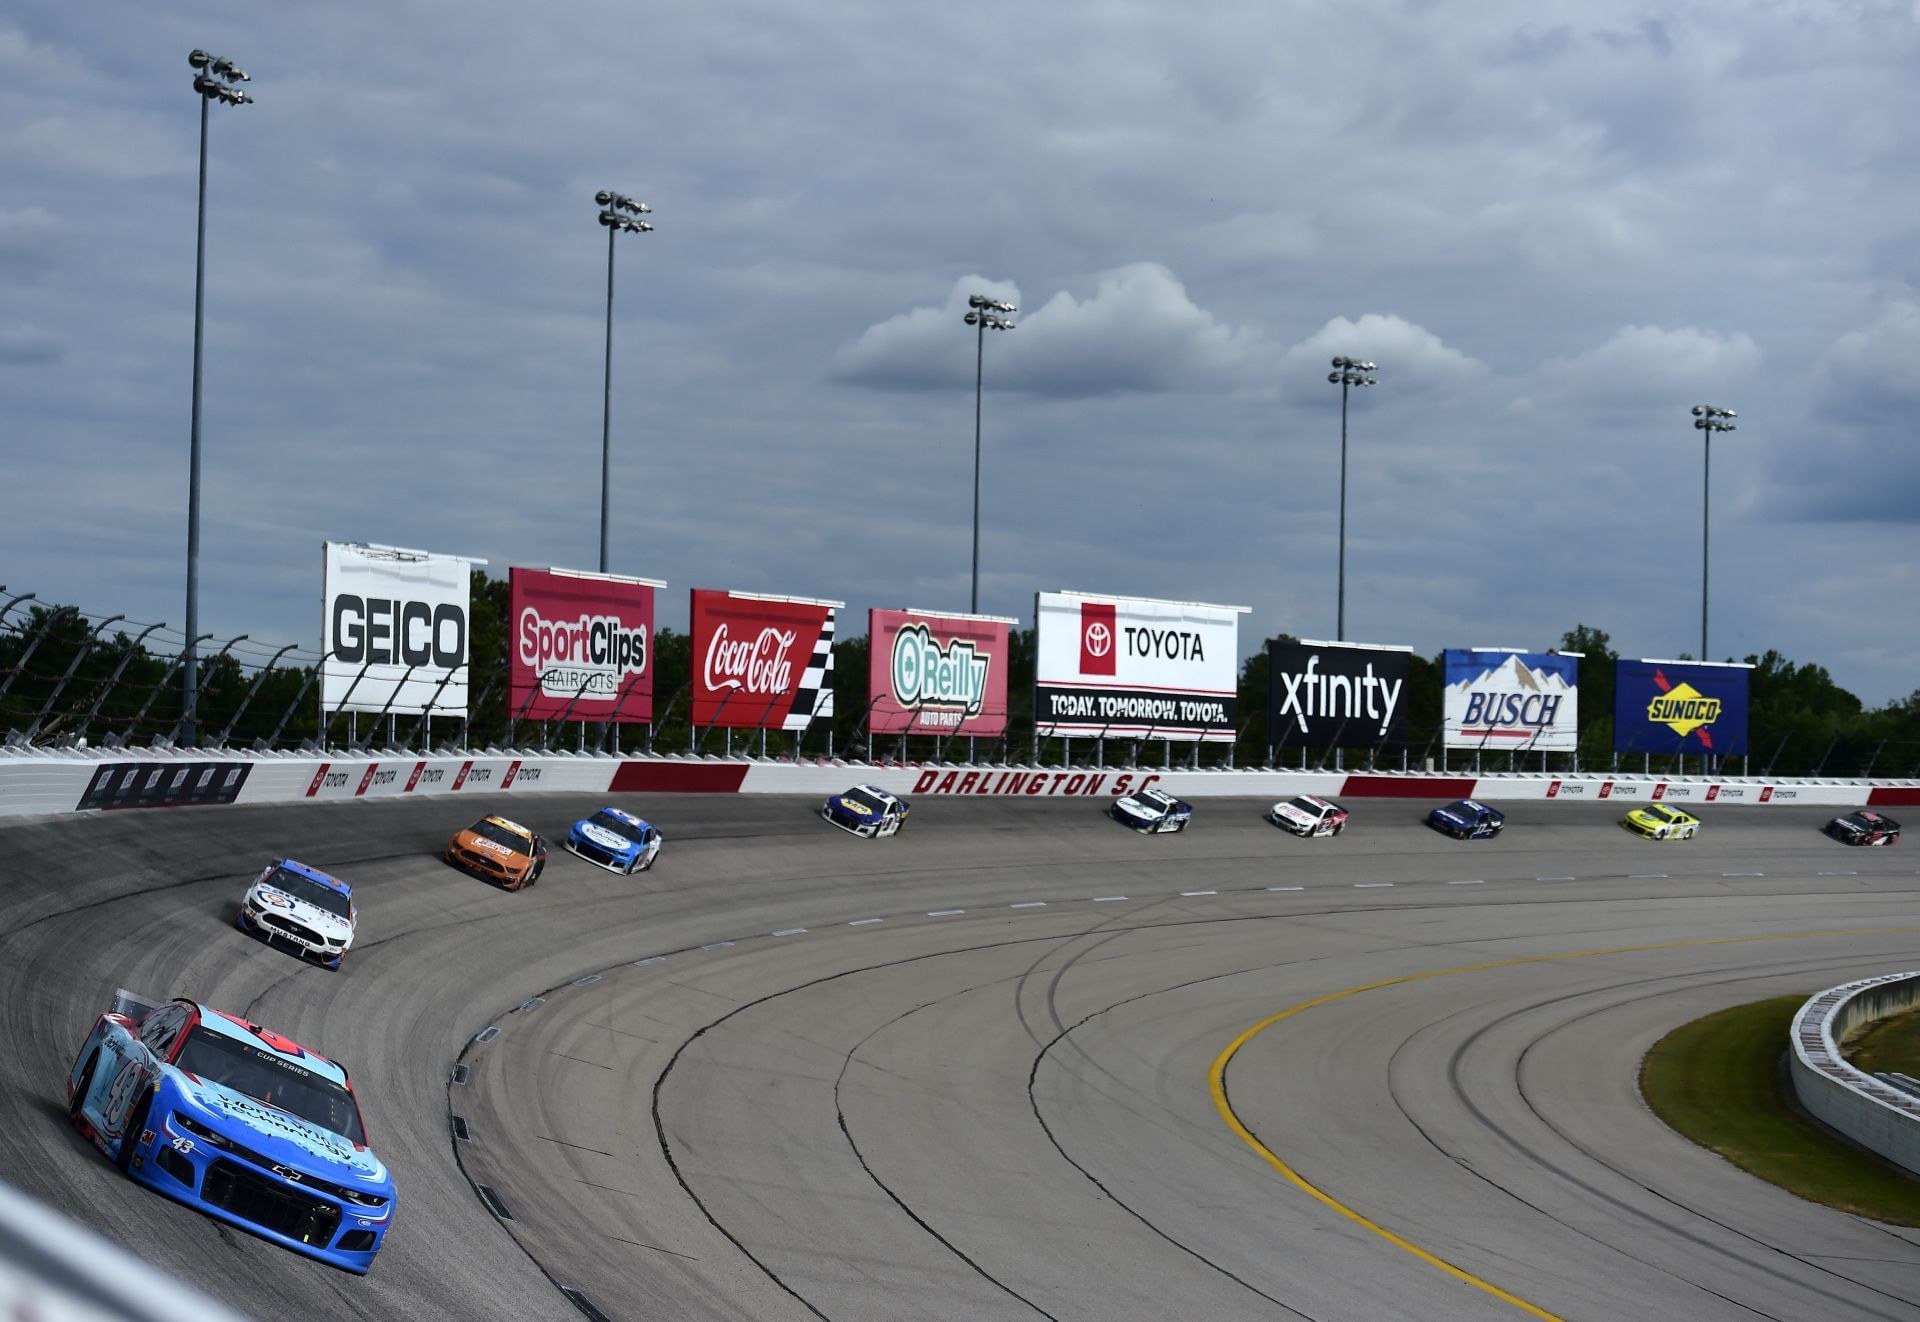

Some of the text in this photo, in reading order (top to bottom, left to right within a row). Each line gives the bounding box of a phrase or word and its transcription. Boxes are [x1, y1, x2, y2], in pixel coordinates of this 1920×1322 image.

[333, 594, 465, 668] GEICO
[522, 613, 644, 675] SportClips
[1125, 627, 1204, 662] TOYOTA
[896, 630, 986, 709] O'Reilly
[547, 671, 614, 689] HAIRCUTS
[1280, 655, 1402, 736] xfinity
[1050, 695, 1228, 723] TODAY. TOMORROW. TOYOTA.
[1462, 692, 1563, 727] BUSCH
[1651, 699, 1717, 721] SUNOCO
[921, 711, 963, 726] AUTO PARTS
[322, 773, 349, 787] TOYOTA
[372, 770, 397, 785] TOYOTA
[419, 770, 444, 783] TOYOTA
[467, 769, 491, 782] TOYOTA
[516, 768, 542, 781] TOYOTA
[912, 770, 1106, 795] DARLINGTON
[1561, 785, 1584, 794] TOYOTA
[1613, 786, 1636, 795] TOYOTA
[1666, 788, 1690, 797] TOYOTA
[1720, 789, 1744, 798] TOYOTA
[1773, 790, 1797, 799] TOYOTA
[270, 926, 311, 947] MUSTANG
[257, 1051, 309, 1077] CUP SERIES
[172, 1137, 195, 1154] 43
